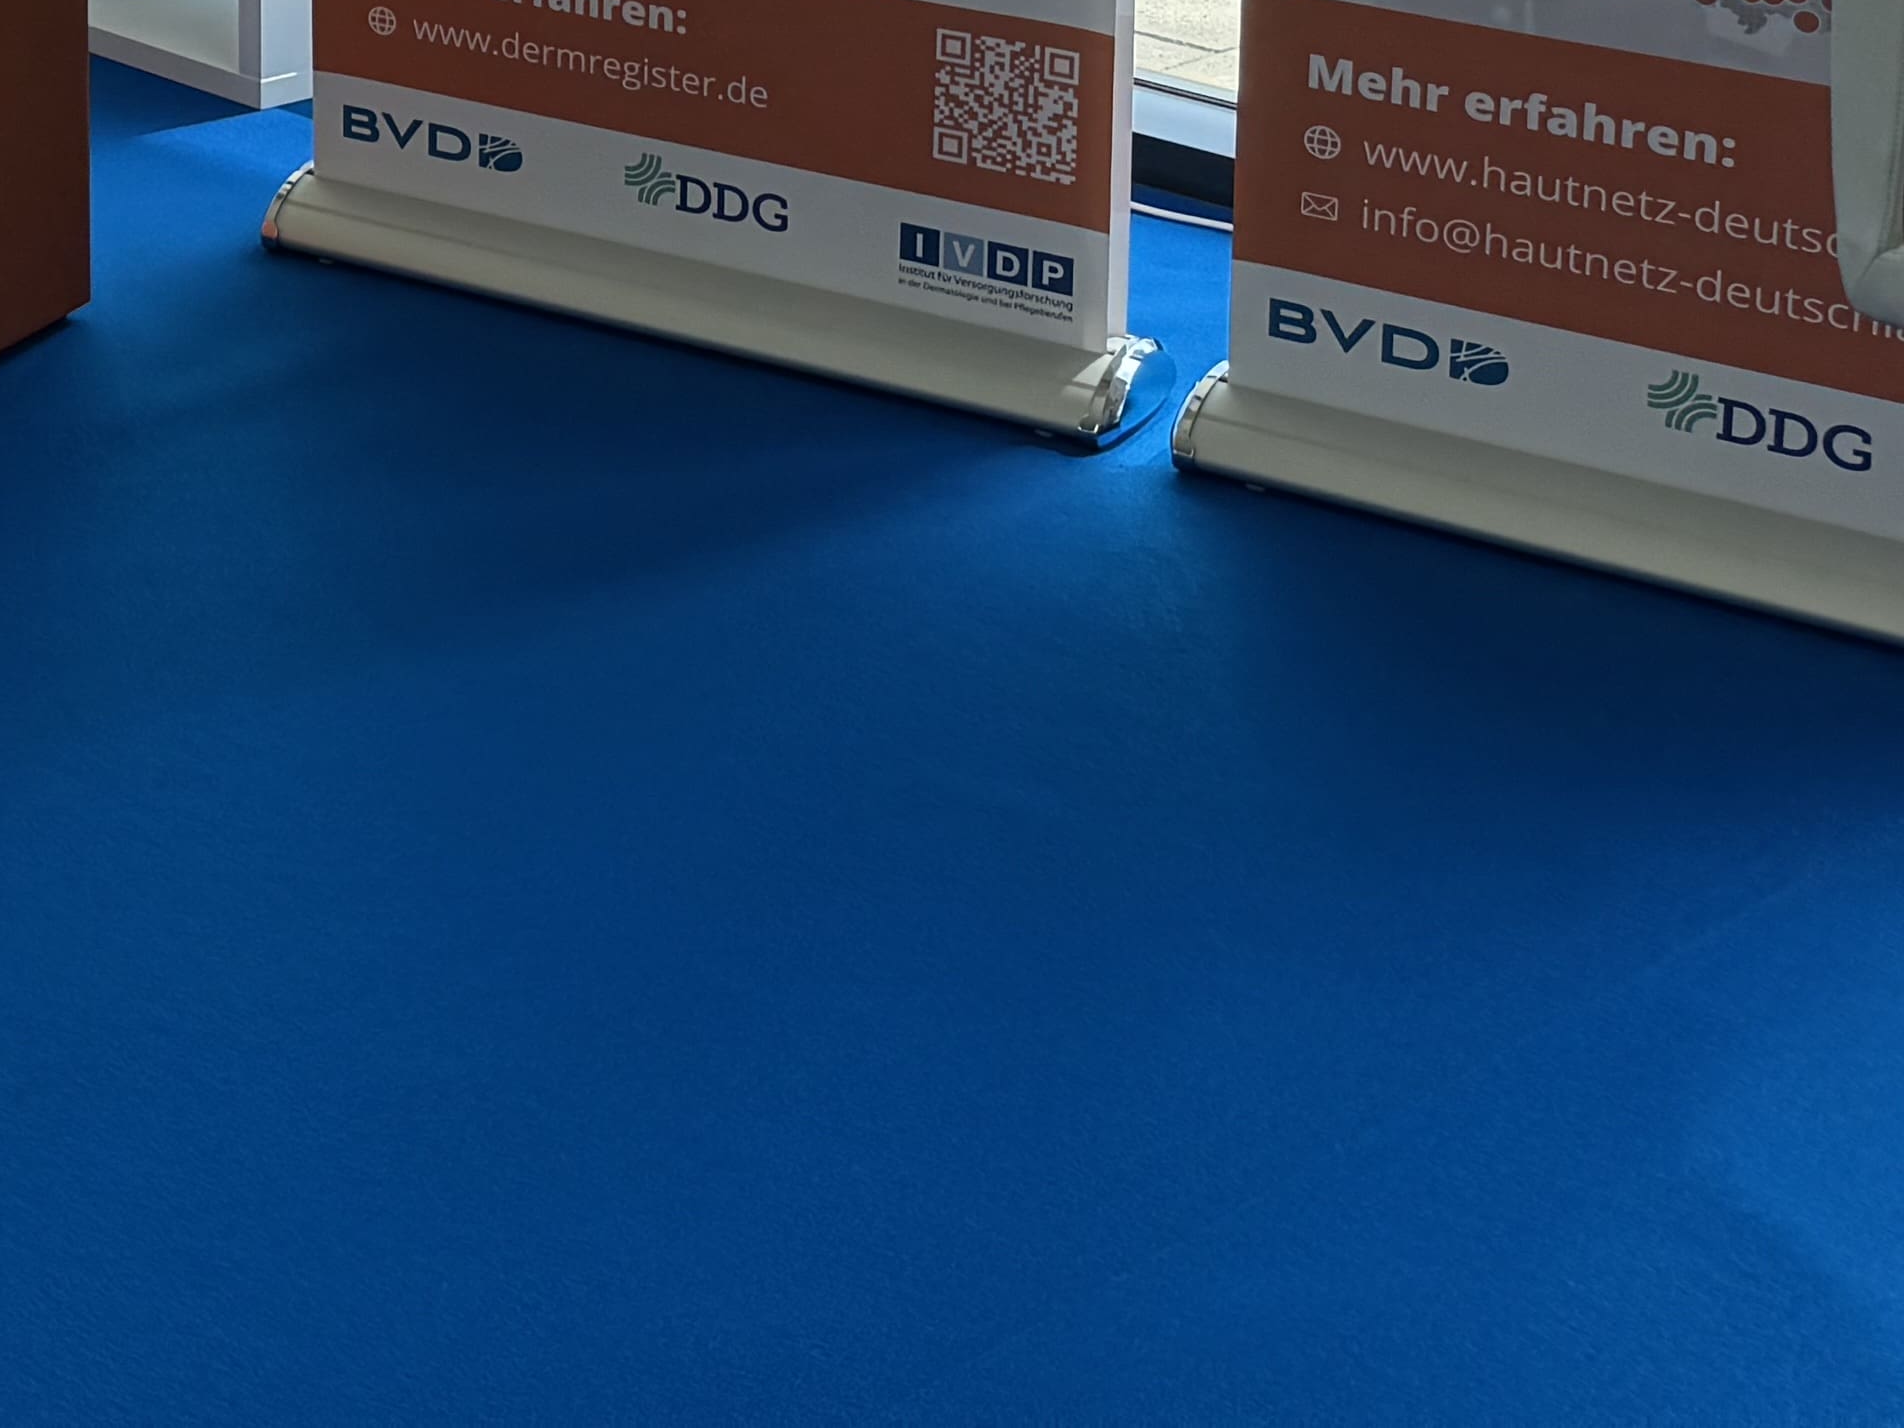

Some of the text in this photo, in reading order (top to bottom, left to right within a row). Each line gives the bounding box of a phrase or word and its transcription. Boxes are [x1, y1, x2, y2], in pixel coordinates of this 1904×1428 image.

[412, 14, 769, 110] www.dermregister.de
[1308, 53, 1736, 169] Mehr erfahren:
[676, 176, 789, 233] DDG
[1363, 138, 1841, 257] www.hautnetz-deutsc
[899, 263, 935, 280] Institut
[937, 272, 951, 282] für
[1716, 396, 1872, 472] DDG
